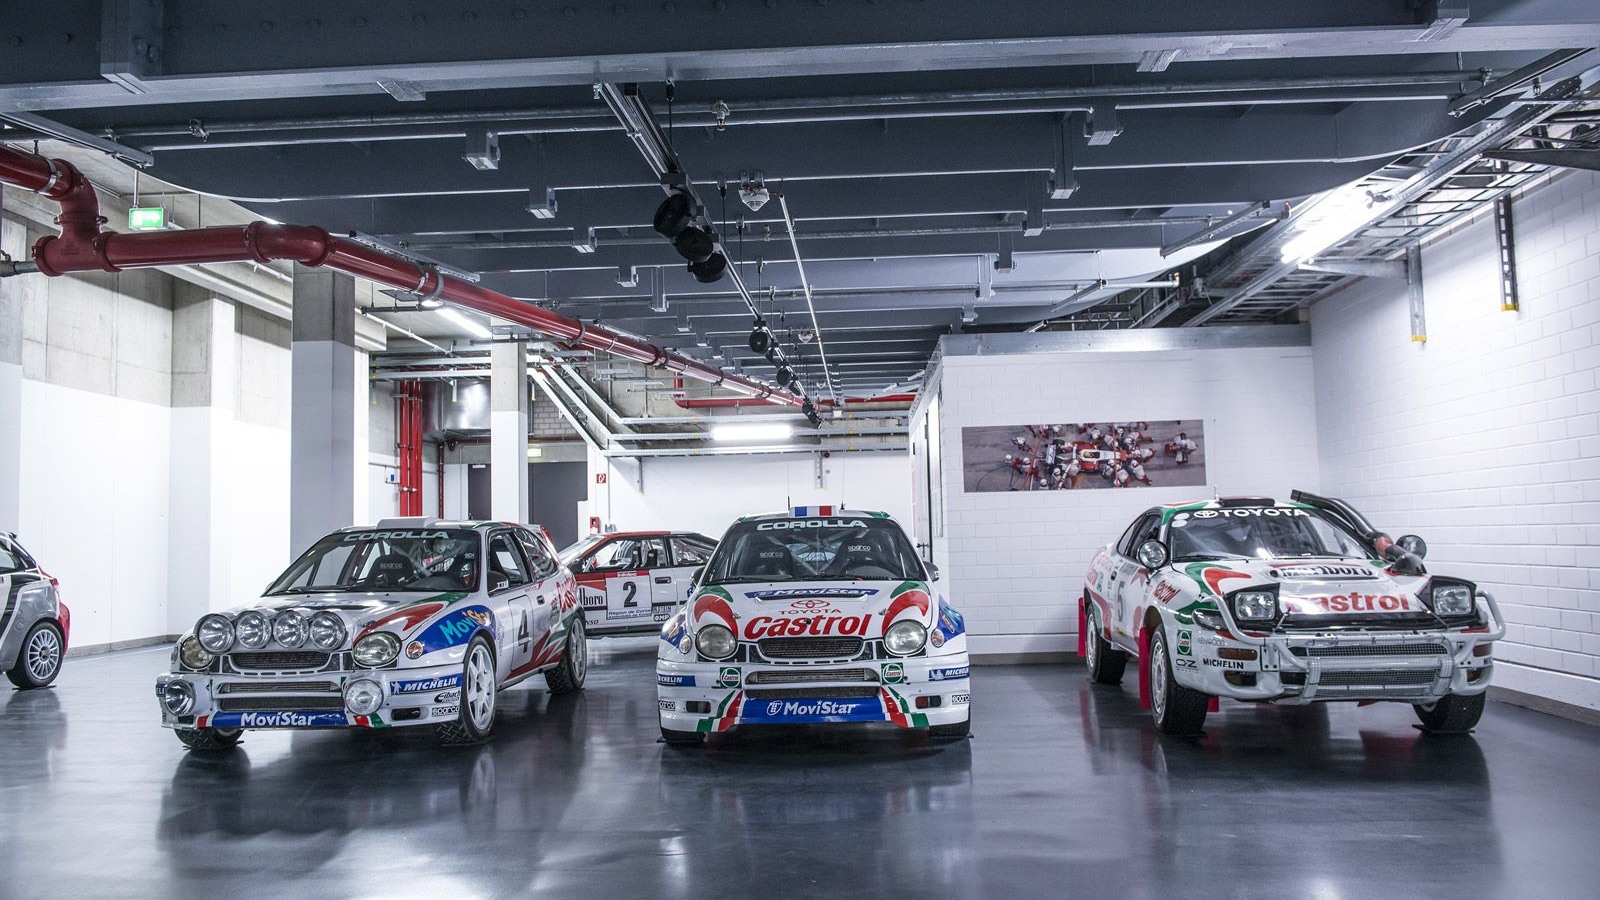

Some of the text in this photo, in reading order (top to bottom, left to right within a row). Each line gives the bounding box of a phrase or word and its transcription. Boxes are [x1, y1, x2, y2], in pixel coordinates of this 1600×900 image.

[1220, 509, 1310, 517] TOYOTA
[757, 520, 867, 530] COROLLA
[344, 531, 449, 541] COROLLA
[623, 581, 638, 608] 2
[1284, 592, 1410, 613] astrol
[518, 609, 529, 653] 4
[743, 613, 873, 640] Castrol
[1175, 659, 1197, 668] OZ
[1202, 658, 1244, 669] MICHELIN
[404, 677, 458, 691] MICHELIN
[783, 700, 856, 715] MoviStar
[241, 711, 316, 727] MoviStar
